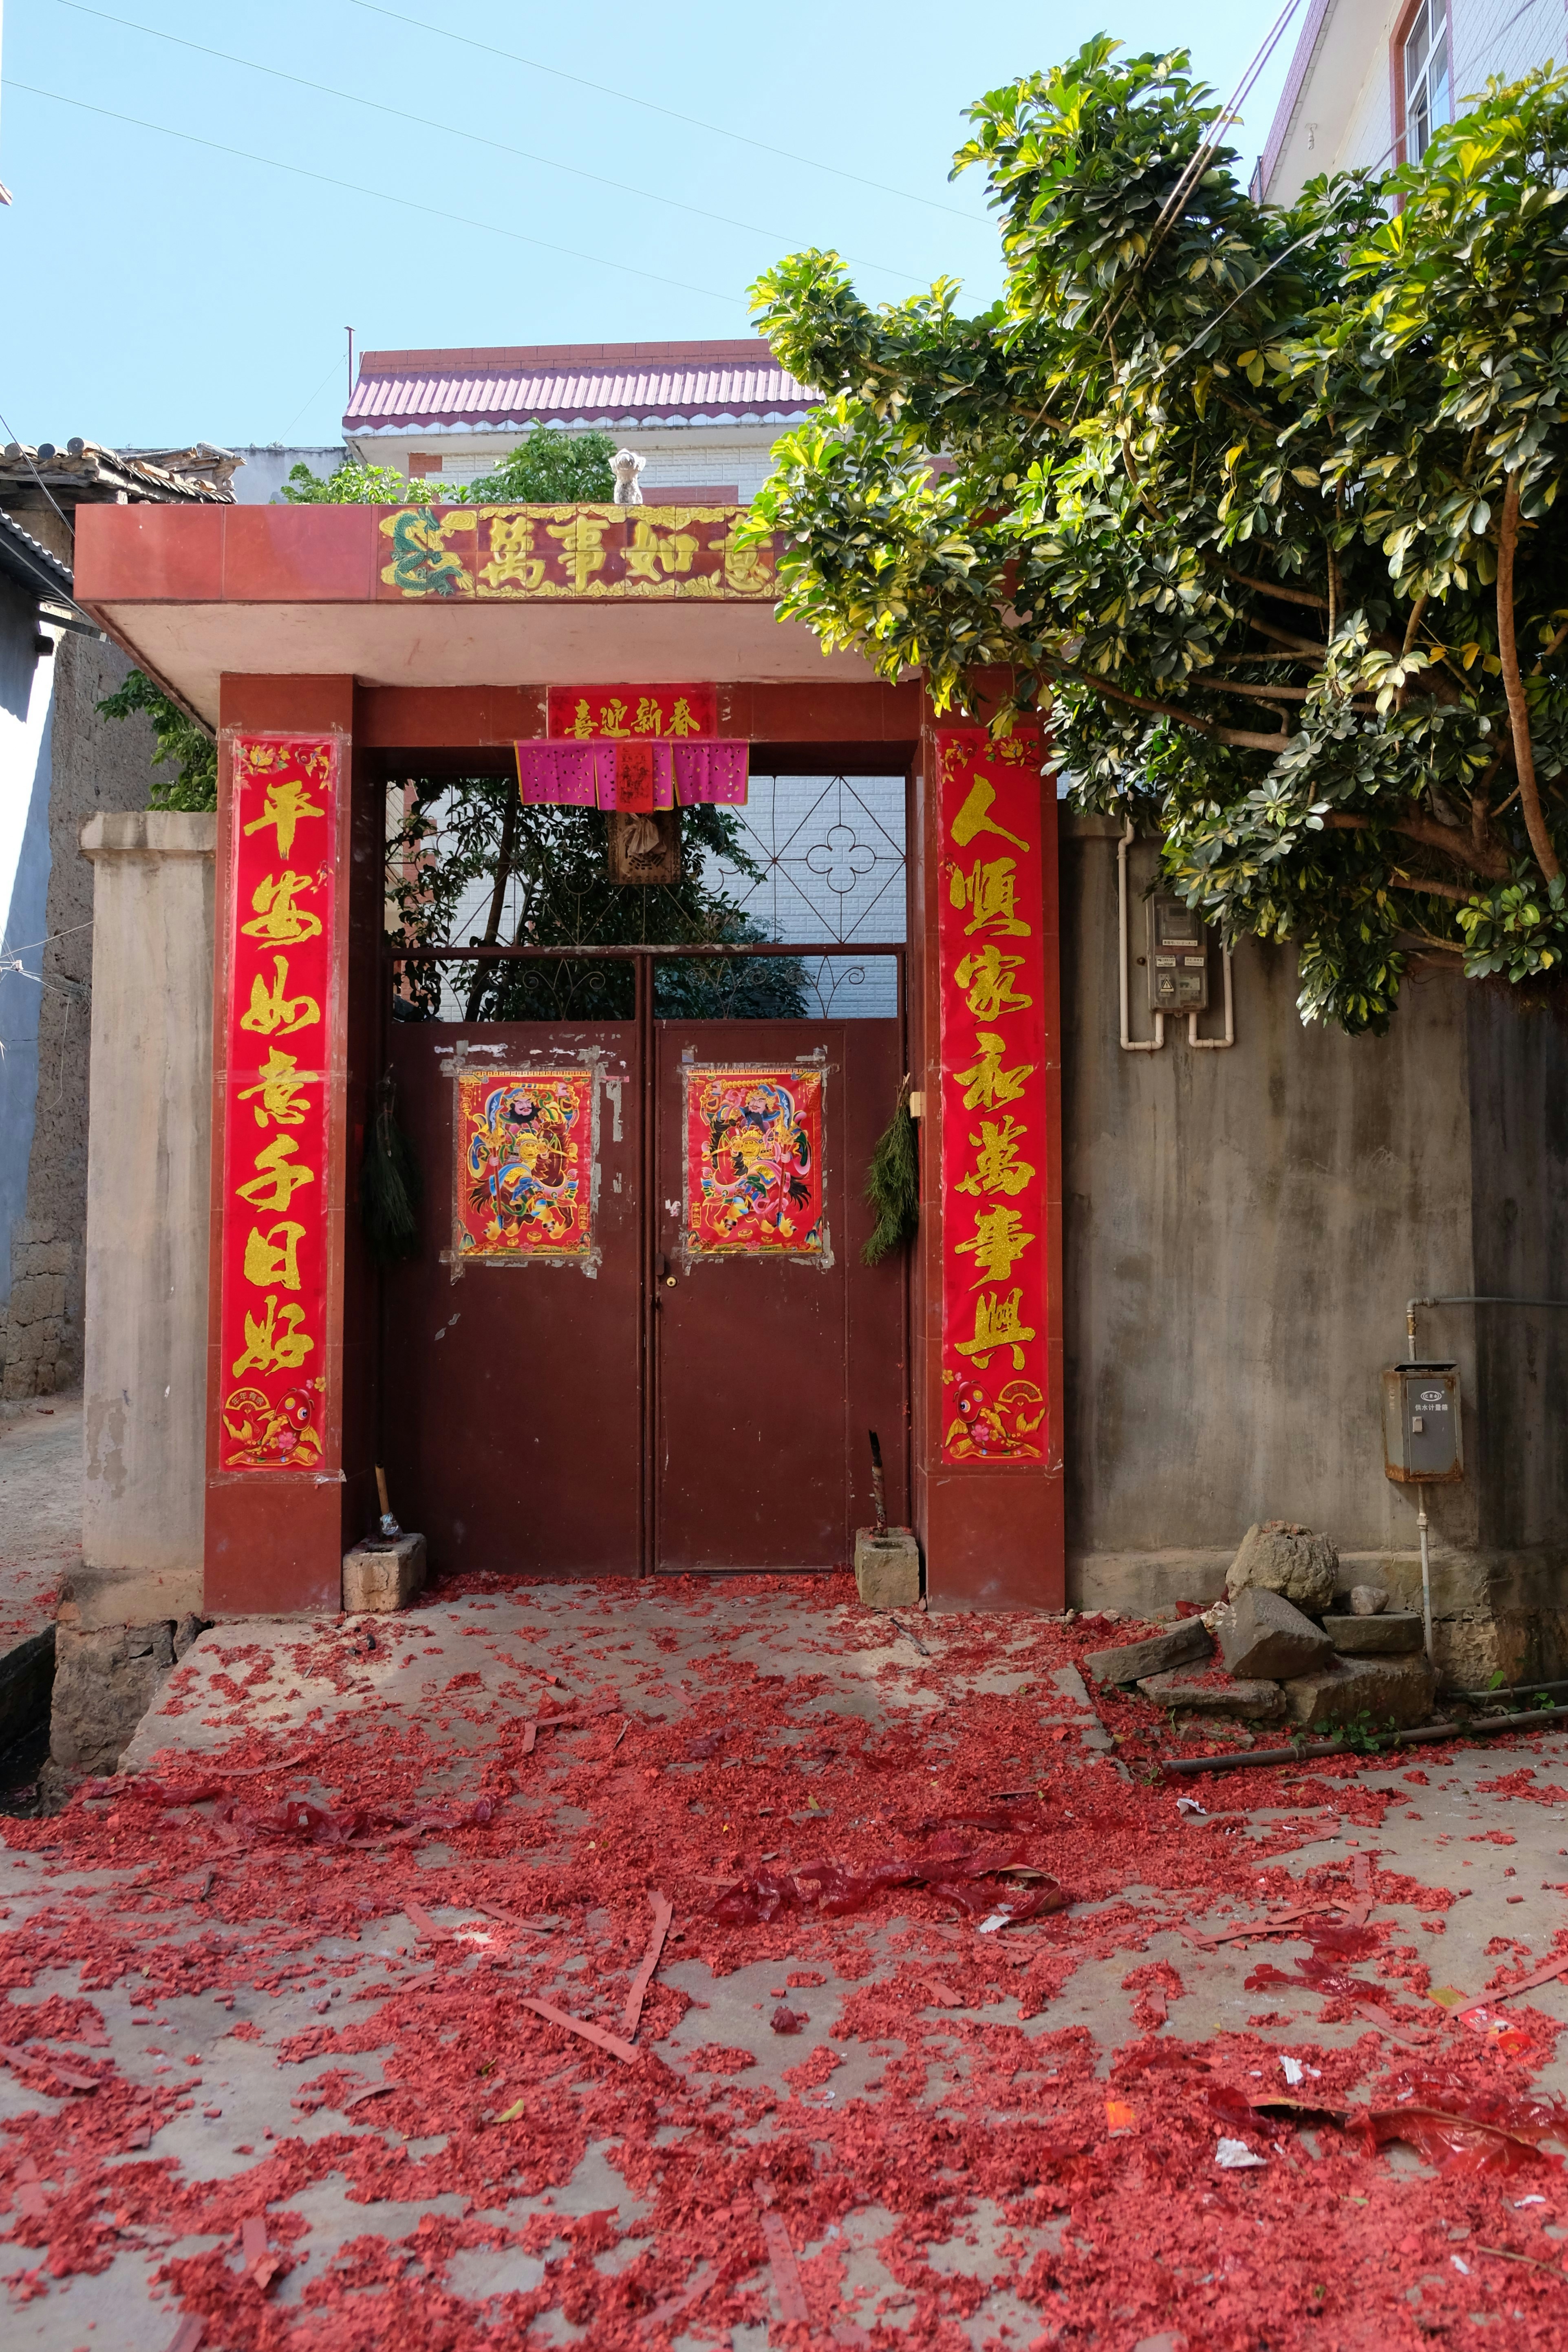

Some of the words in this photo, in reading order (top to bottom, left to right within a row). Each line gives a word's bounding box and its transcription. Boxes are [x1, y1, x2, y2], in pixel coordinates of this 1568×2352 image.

[478, 514, 773, 592] 萬事如意
[565, 697, 700, 739] 喜迎新春
[232, 780, 325, 1378] 平安如意千日好
